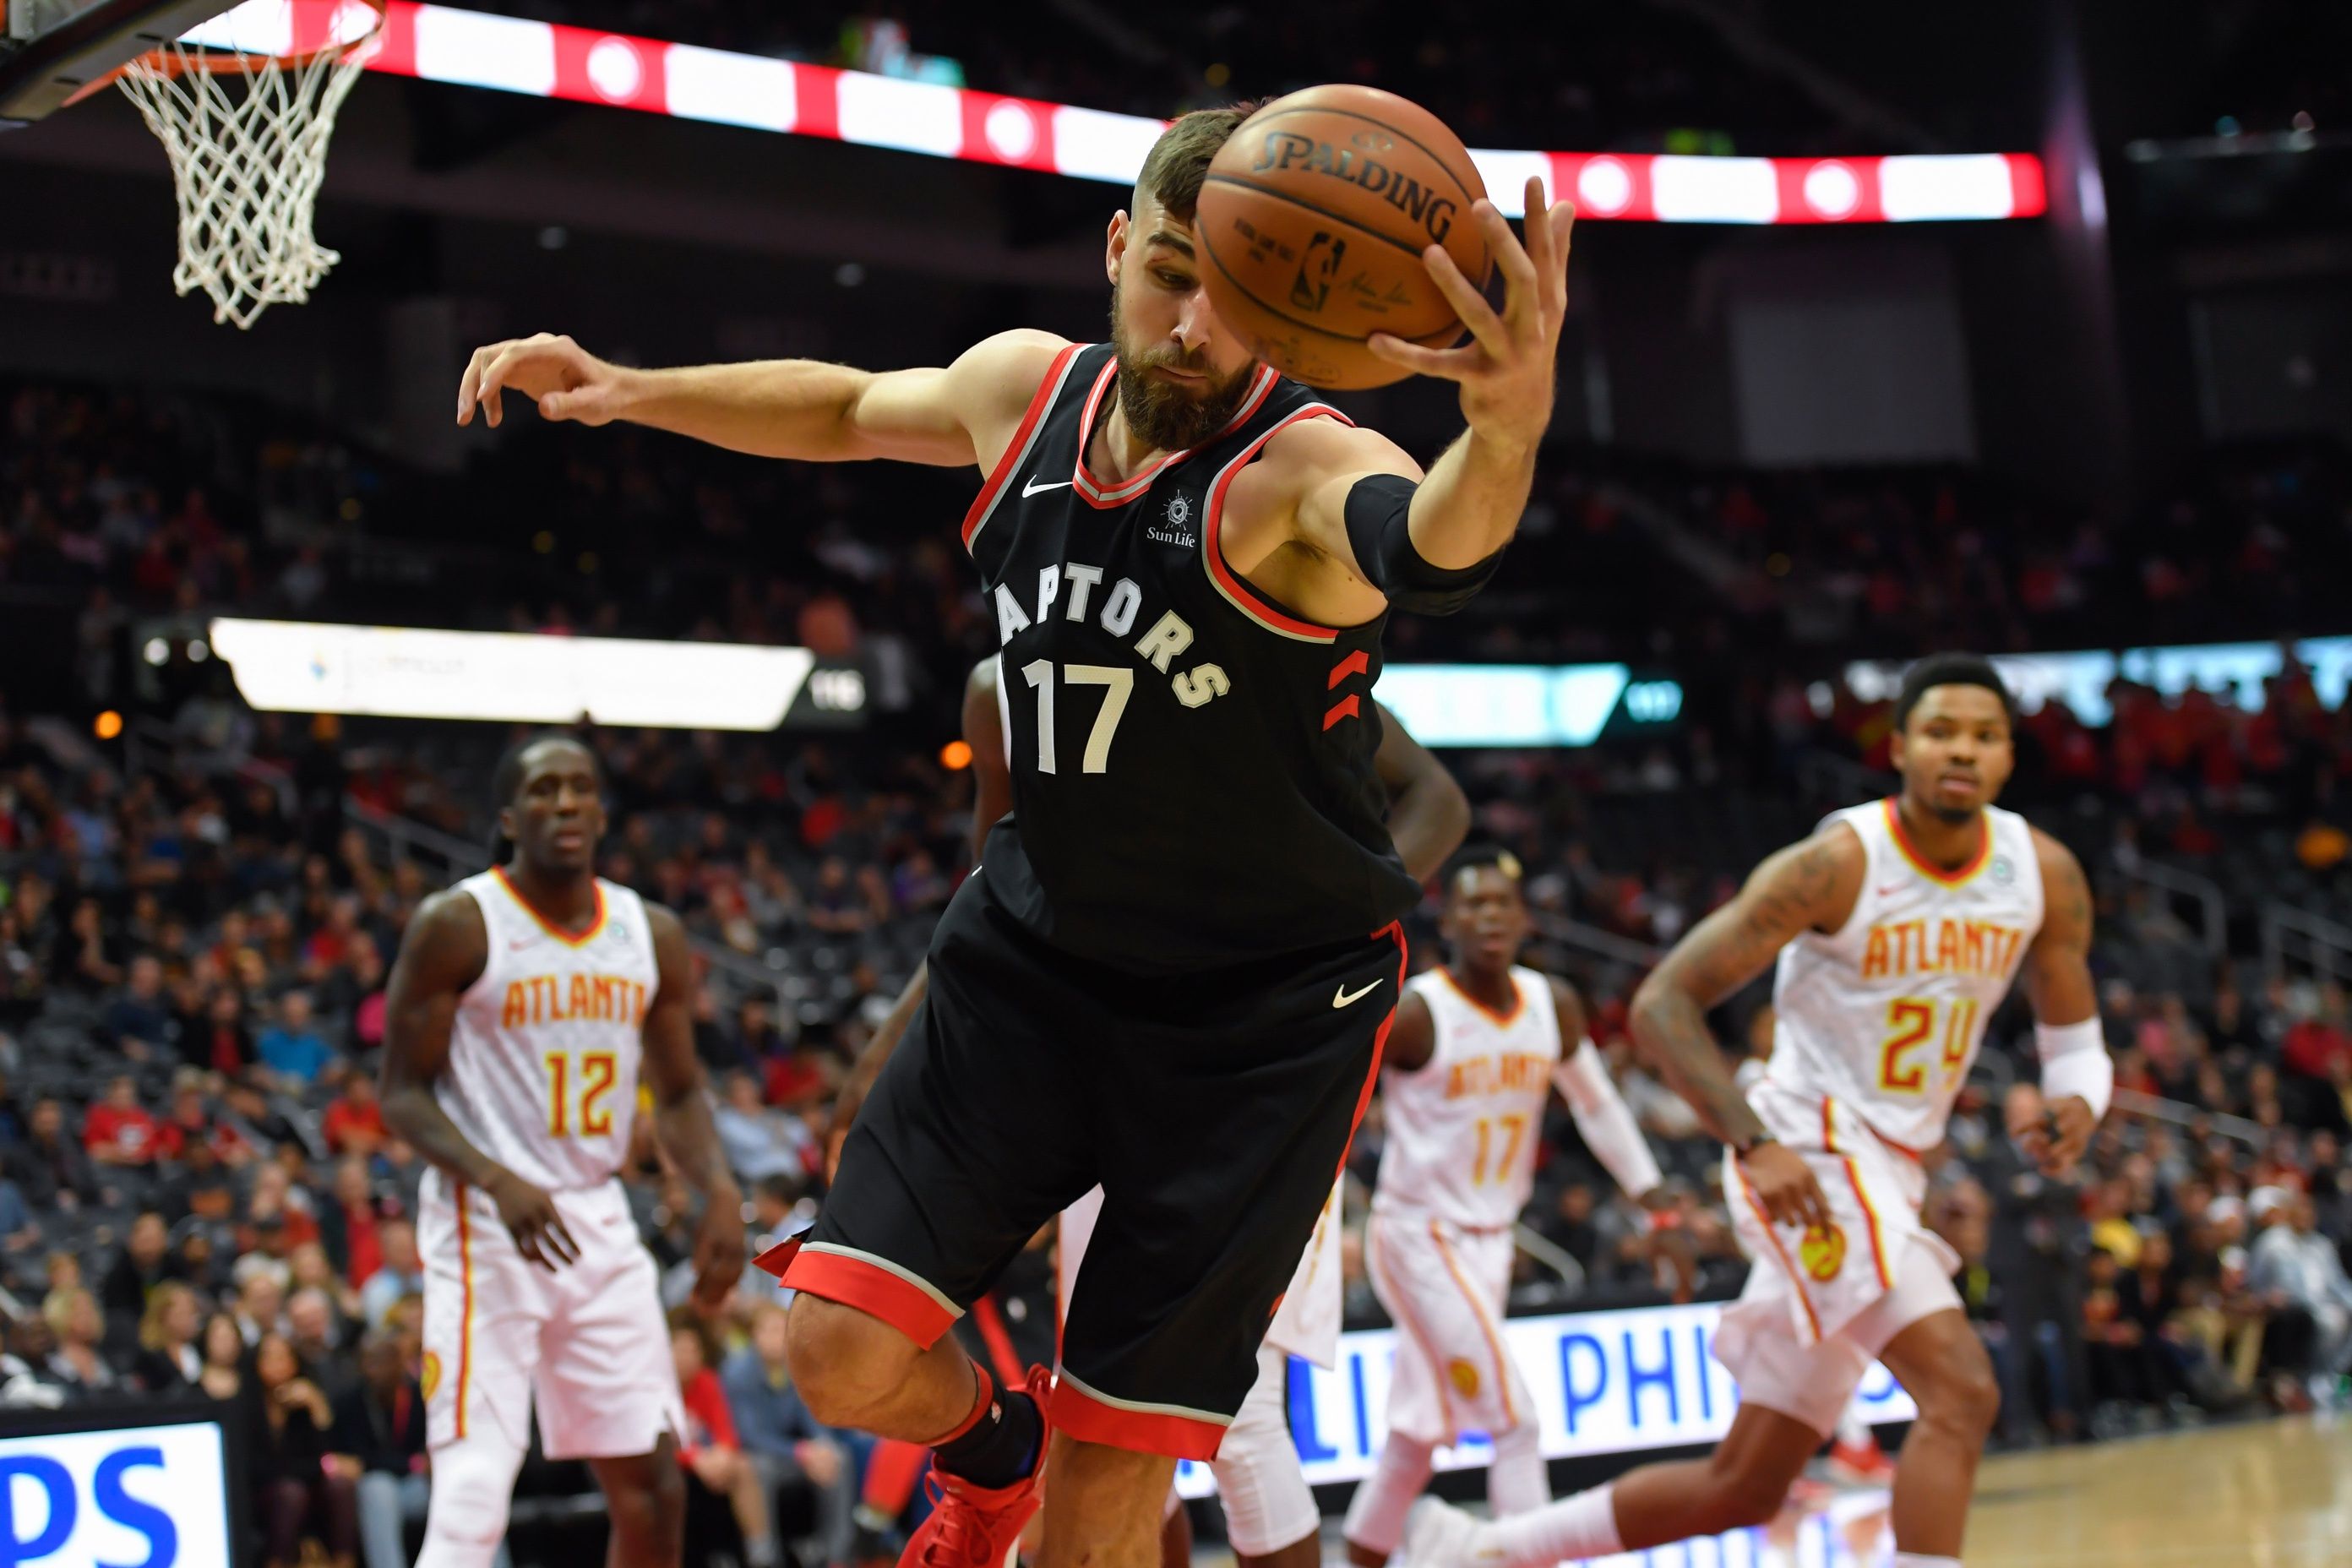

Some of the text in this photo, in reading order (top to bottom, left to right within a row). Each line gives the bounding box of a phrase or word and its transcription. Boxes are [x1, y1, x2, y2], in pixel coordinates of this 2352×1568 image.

[1254, 131, 1456, 245] SPALDING
[1146, 526, 1195, 548] Sun Life
[994, 562, 1231, 709] APTORS
[1021, 658, 1135, 775] 17
[1881, 997, 1979, 1092] 24
[545, 1051, 618, 1137] 12
[1472, 1113, 1527, 1187] 17
